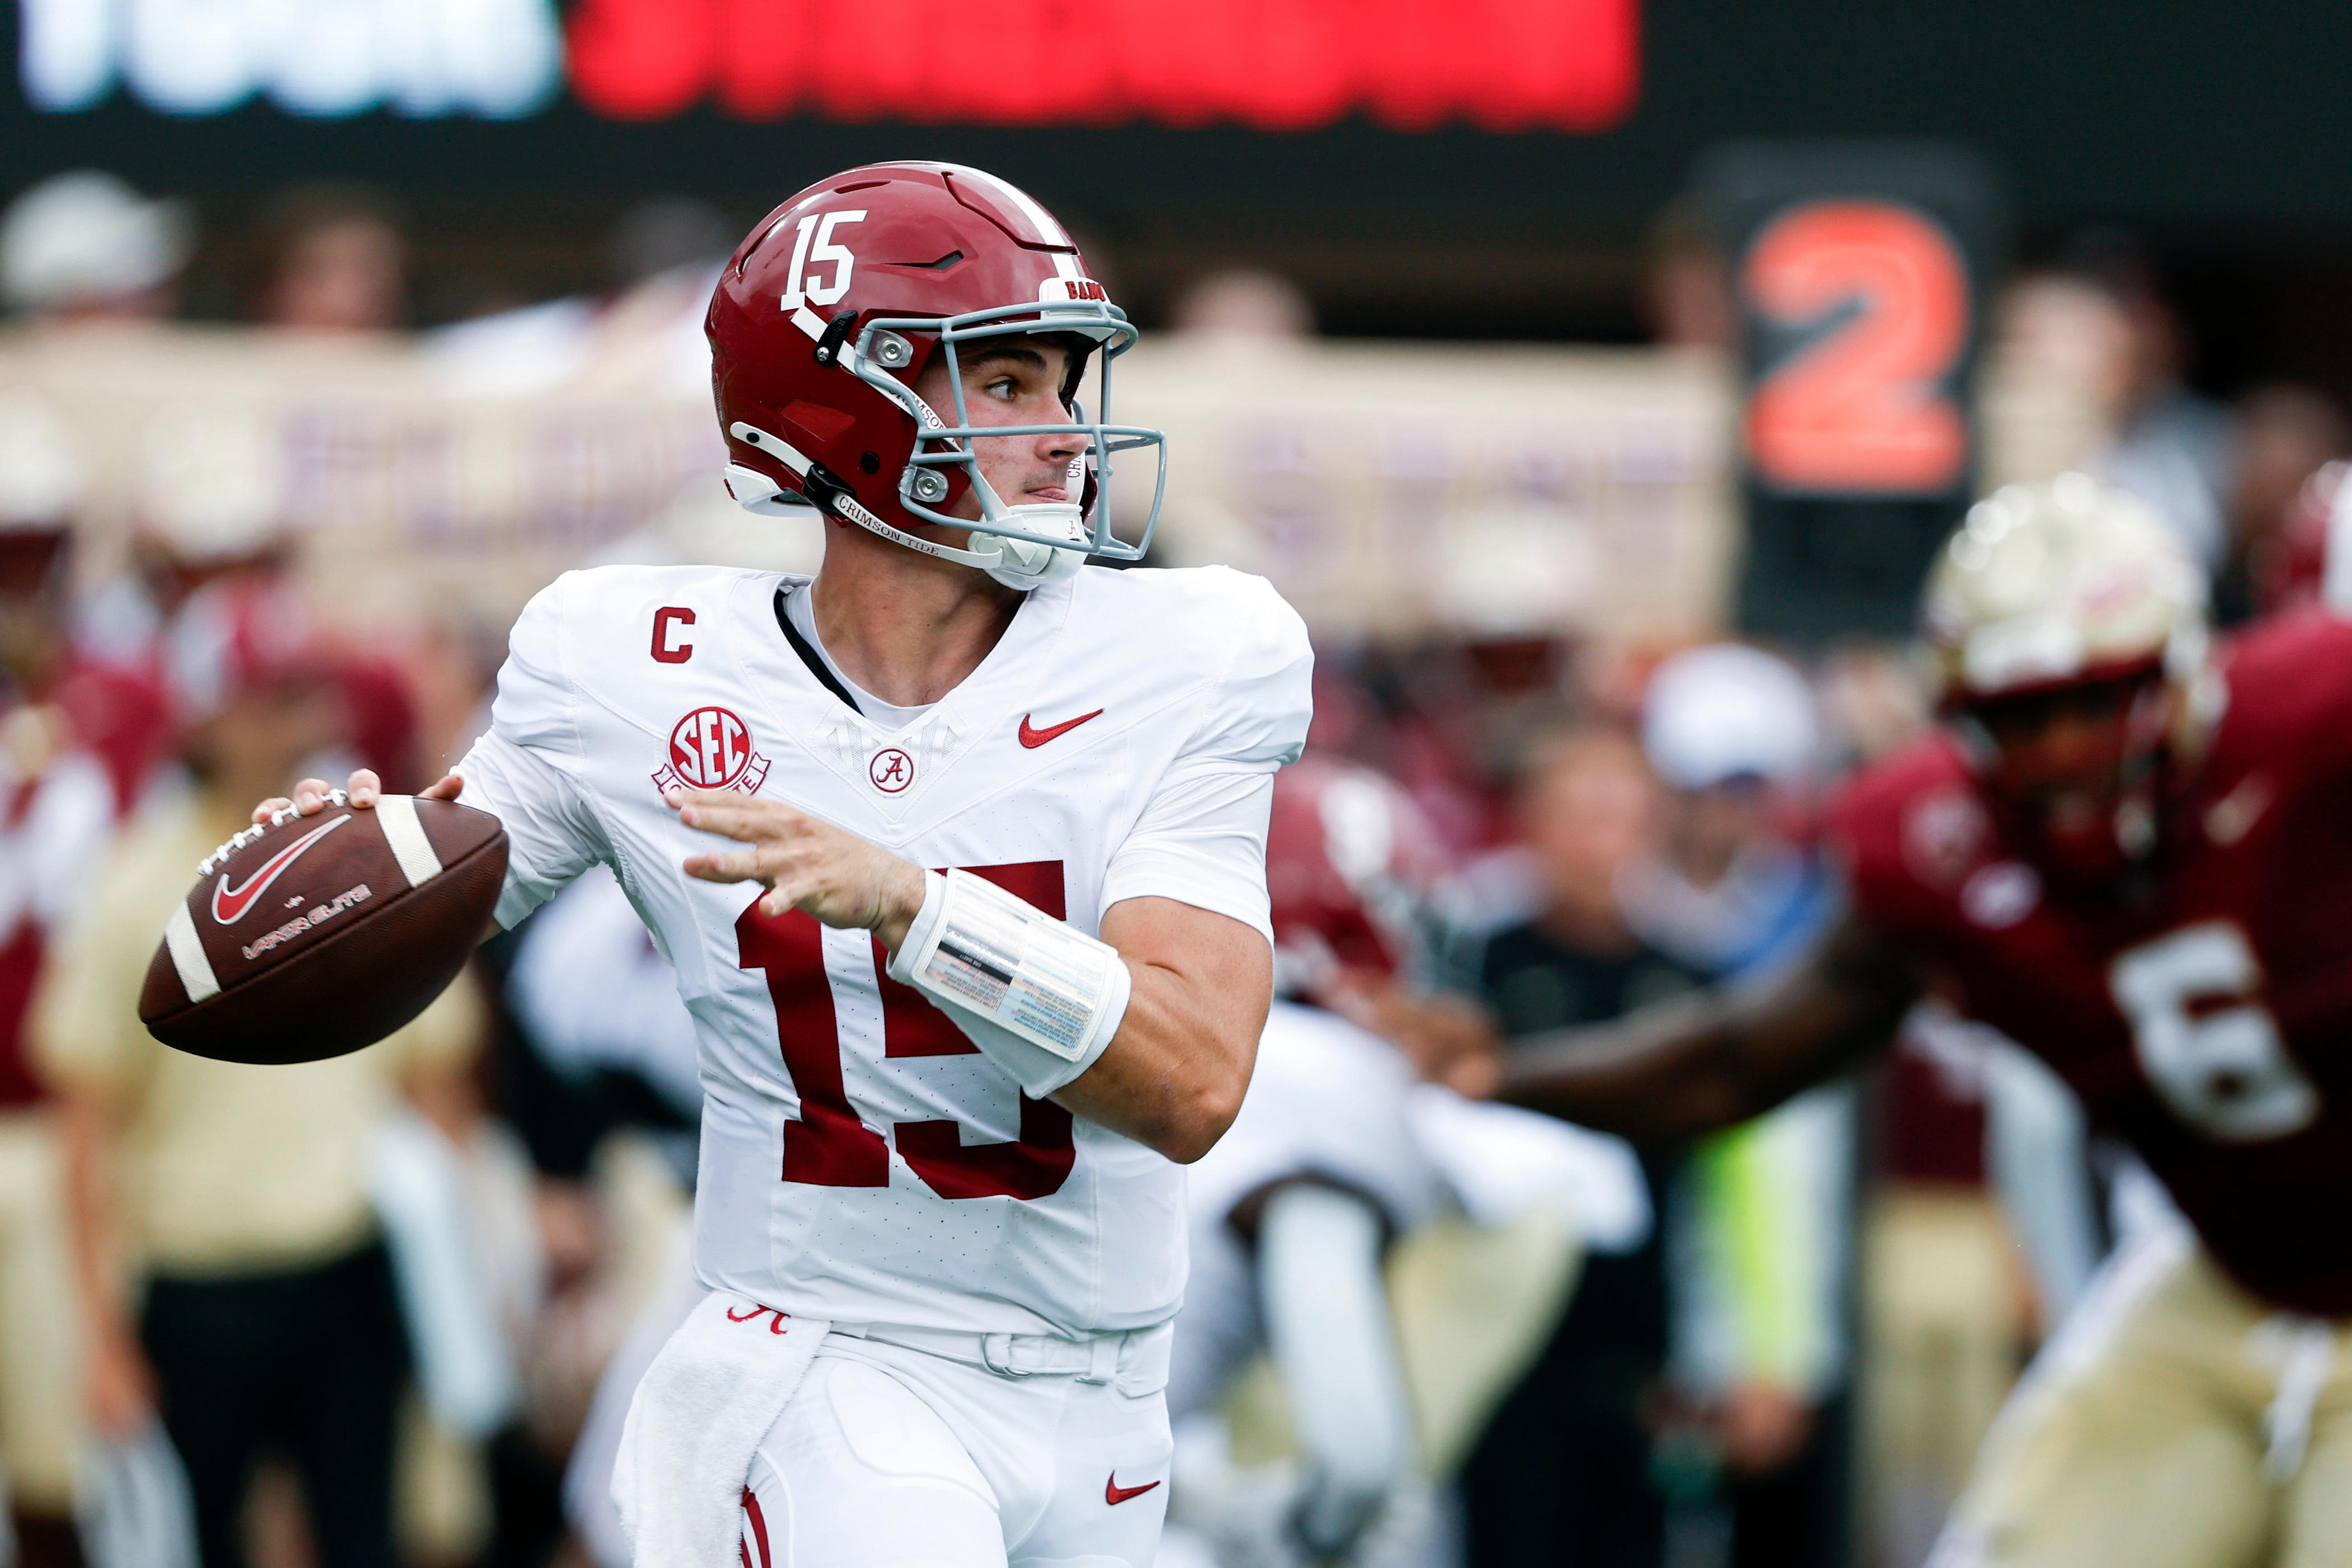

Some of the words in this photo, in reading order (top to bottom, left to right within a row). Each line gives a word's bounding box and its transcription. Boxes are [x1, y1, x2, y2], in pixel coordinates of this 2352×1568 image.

[781, 210, 868, 311] 15
[1741, 202, 1968, 491] 2
[839, 496, 900, 541] CRIMSON
[906, 538, 939, 555] TIDE
[650, 606, 696, 664] C
[674, 711, 745, 785] SEC
[307, 884, 372, 925] ELITE
[734, 859, 1076, 1201] 15
